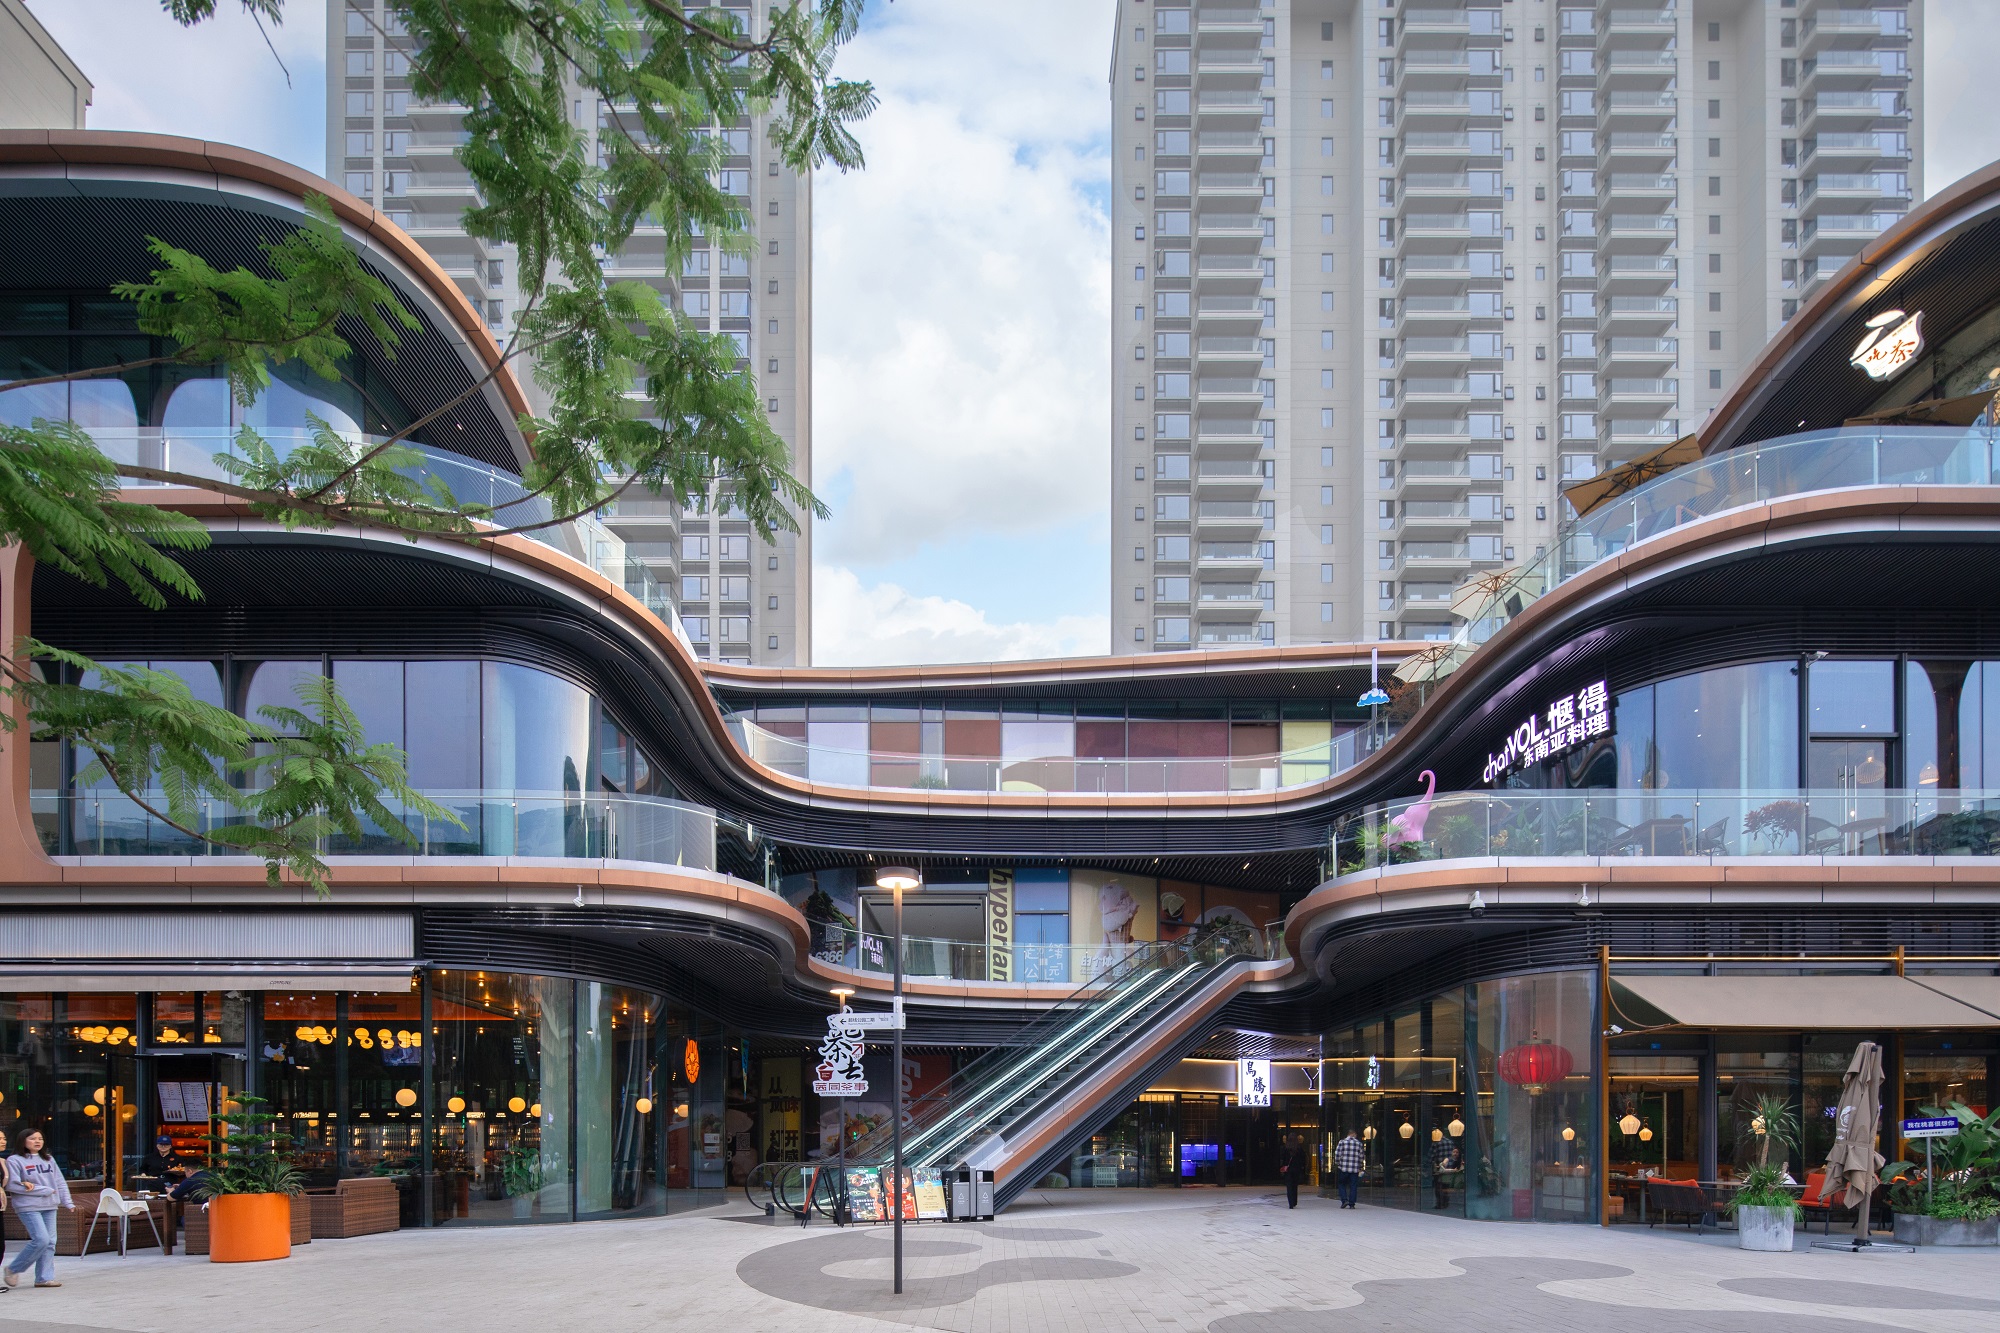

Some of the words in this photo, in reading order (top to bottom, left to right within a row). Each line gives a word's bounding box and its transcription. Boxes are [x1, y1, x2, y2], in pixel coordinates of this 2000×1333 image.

[1523, 710, 1610, 769] 东南亚料理
[25, 1164, 53, 1175] FILA
